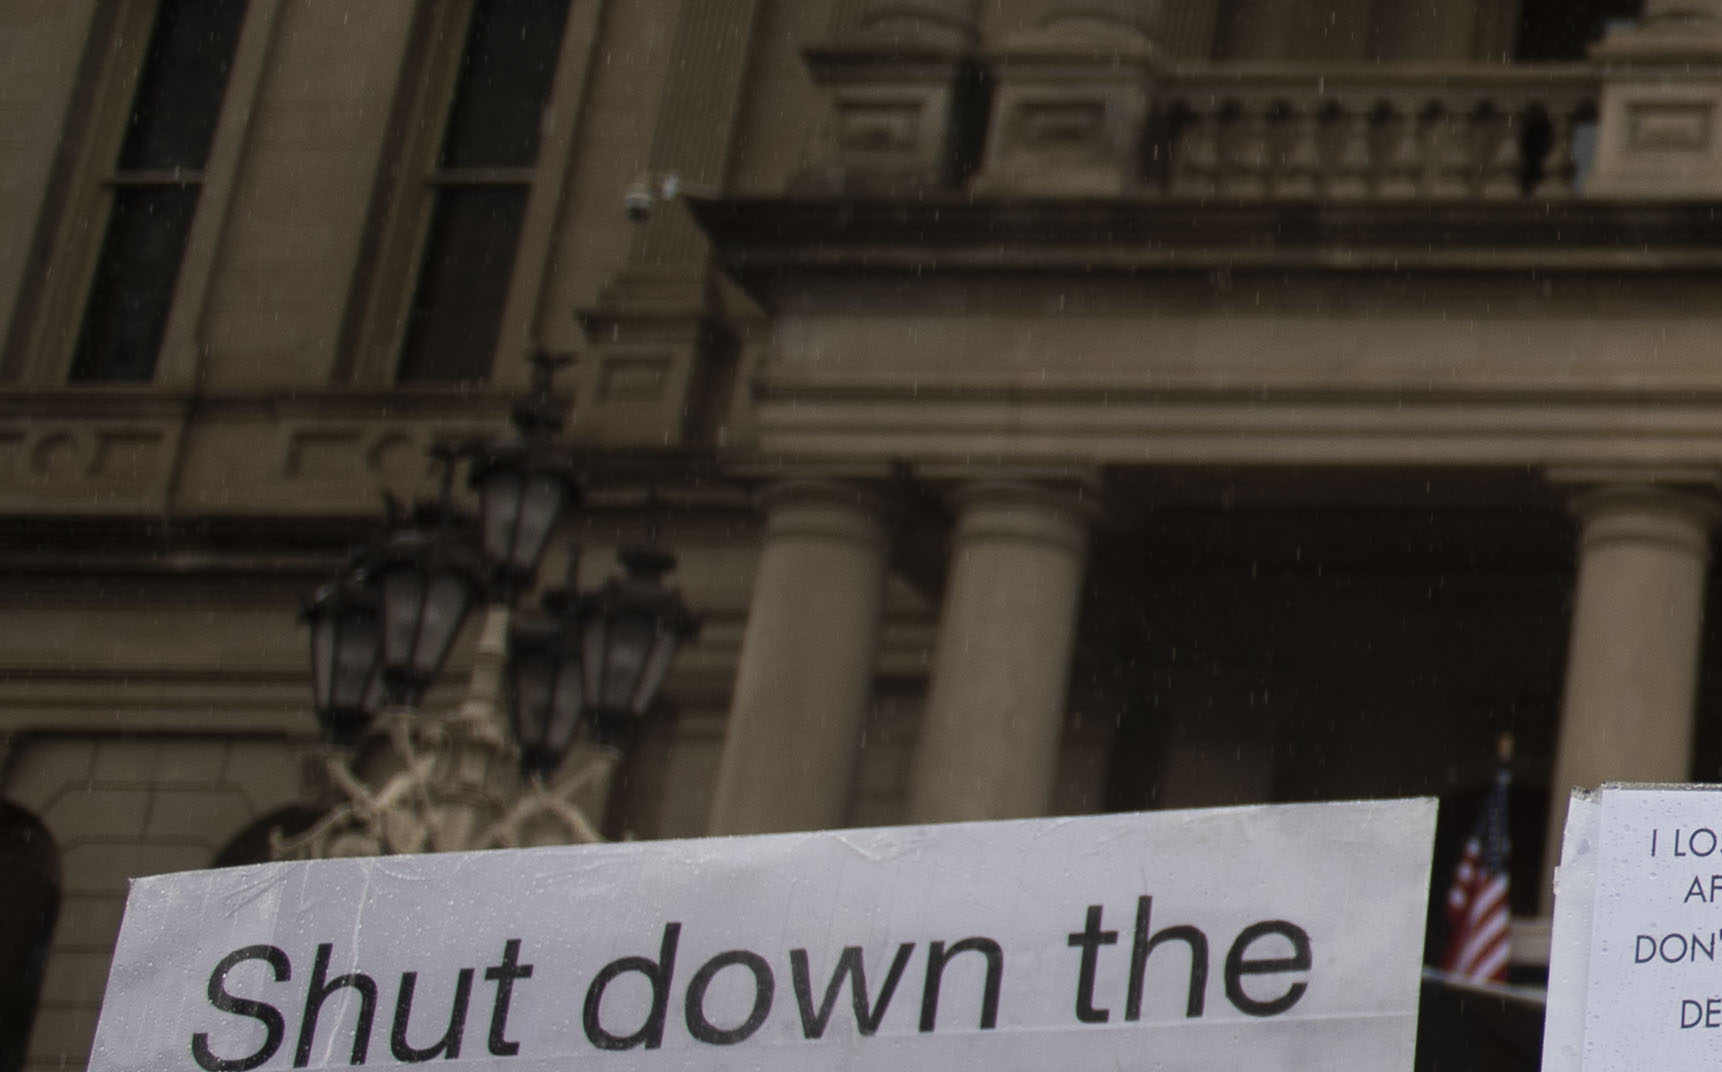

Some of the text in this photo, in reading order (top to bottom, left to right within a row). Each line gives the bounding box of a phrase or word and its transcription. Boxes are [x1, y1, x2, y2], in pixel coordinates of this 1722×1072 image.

[1650, 828, 1658, 858] I
[582, 922, 1003, 1051] down
[1067, 895, 1312, 1024] the
